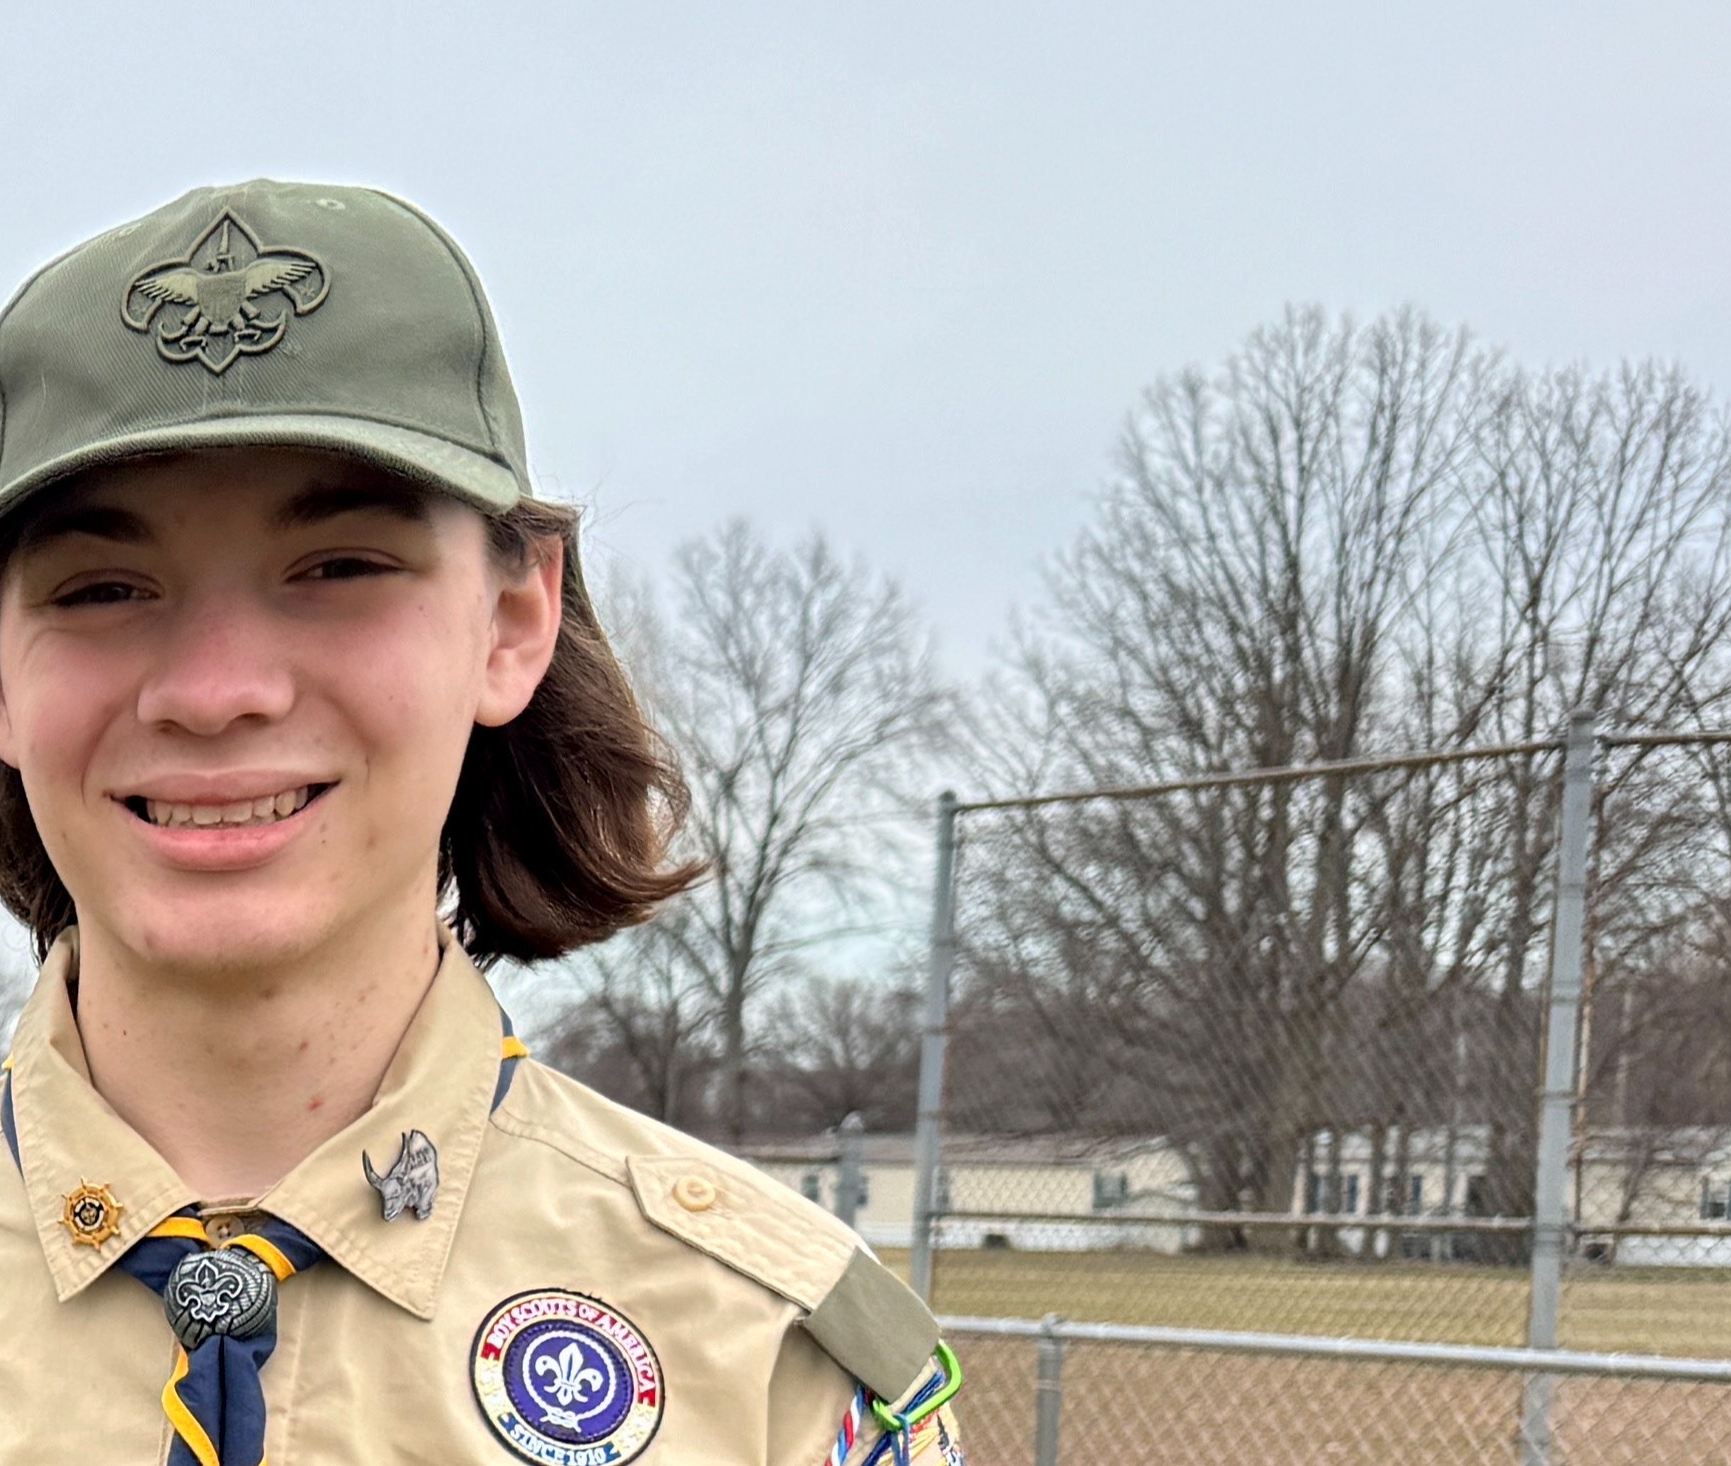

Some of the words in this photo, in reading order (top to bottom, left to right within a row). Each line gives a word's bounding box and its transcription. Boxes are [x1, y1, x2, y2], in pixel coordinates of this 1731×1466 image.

[486, 1312, 517, 1350] BOY
[510, 1298, 578, 1325] SCOUTS
[578, 1303, 601, 1322] OF
[594, 1313, 656, 1389] AMERICA
[509, 1423, 566, 1466] SINCE
